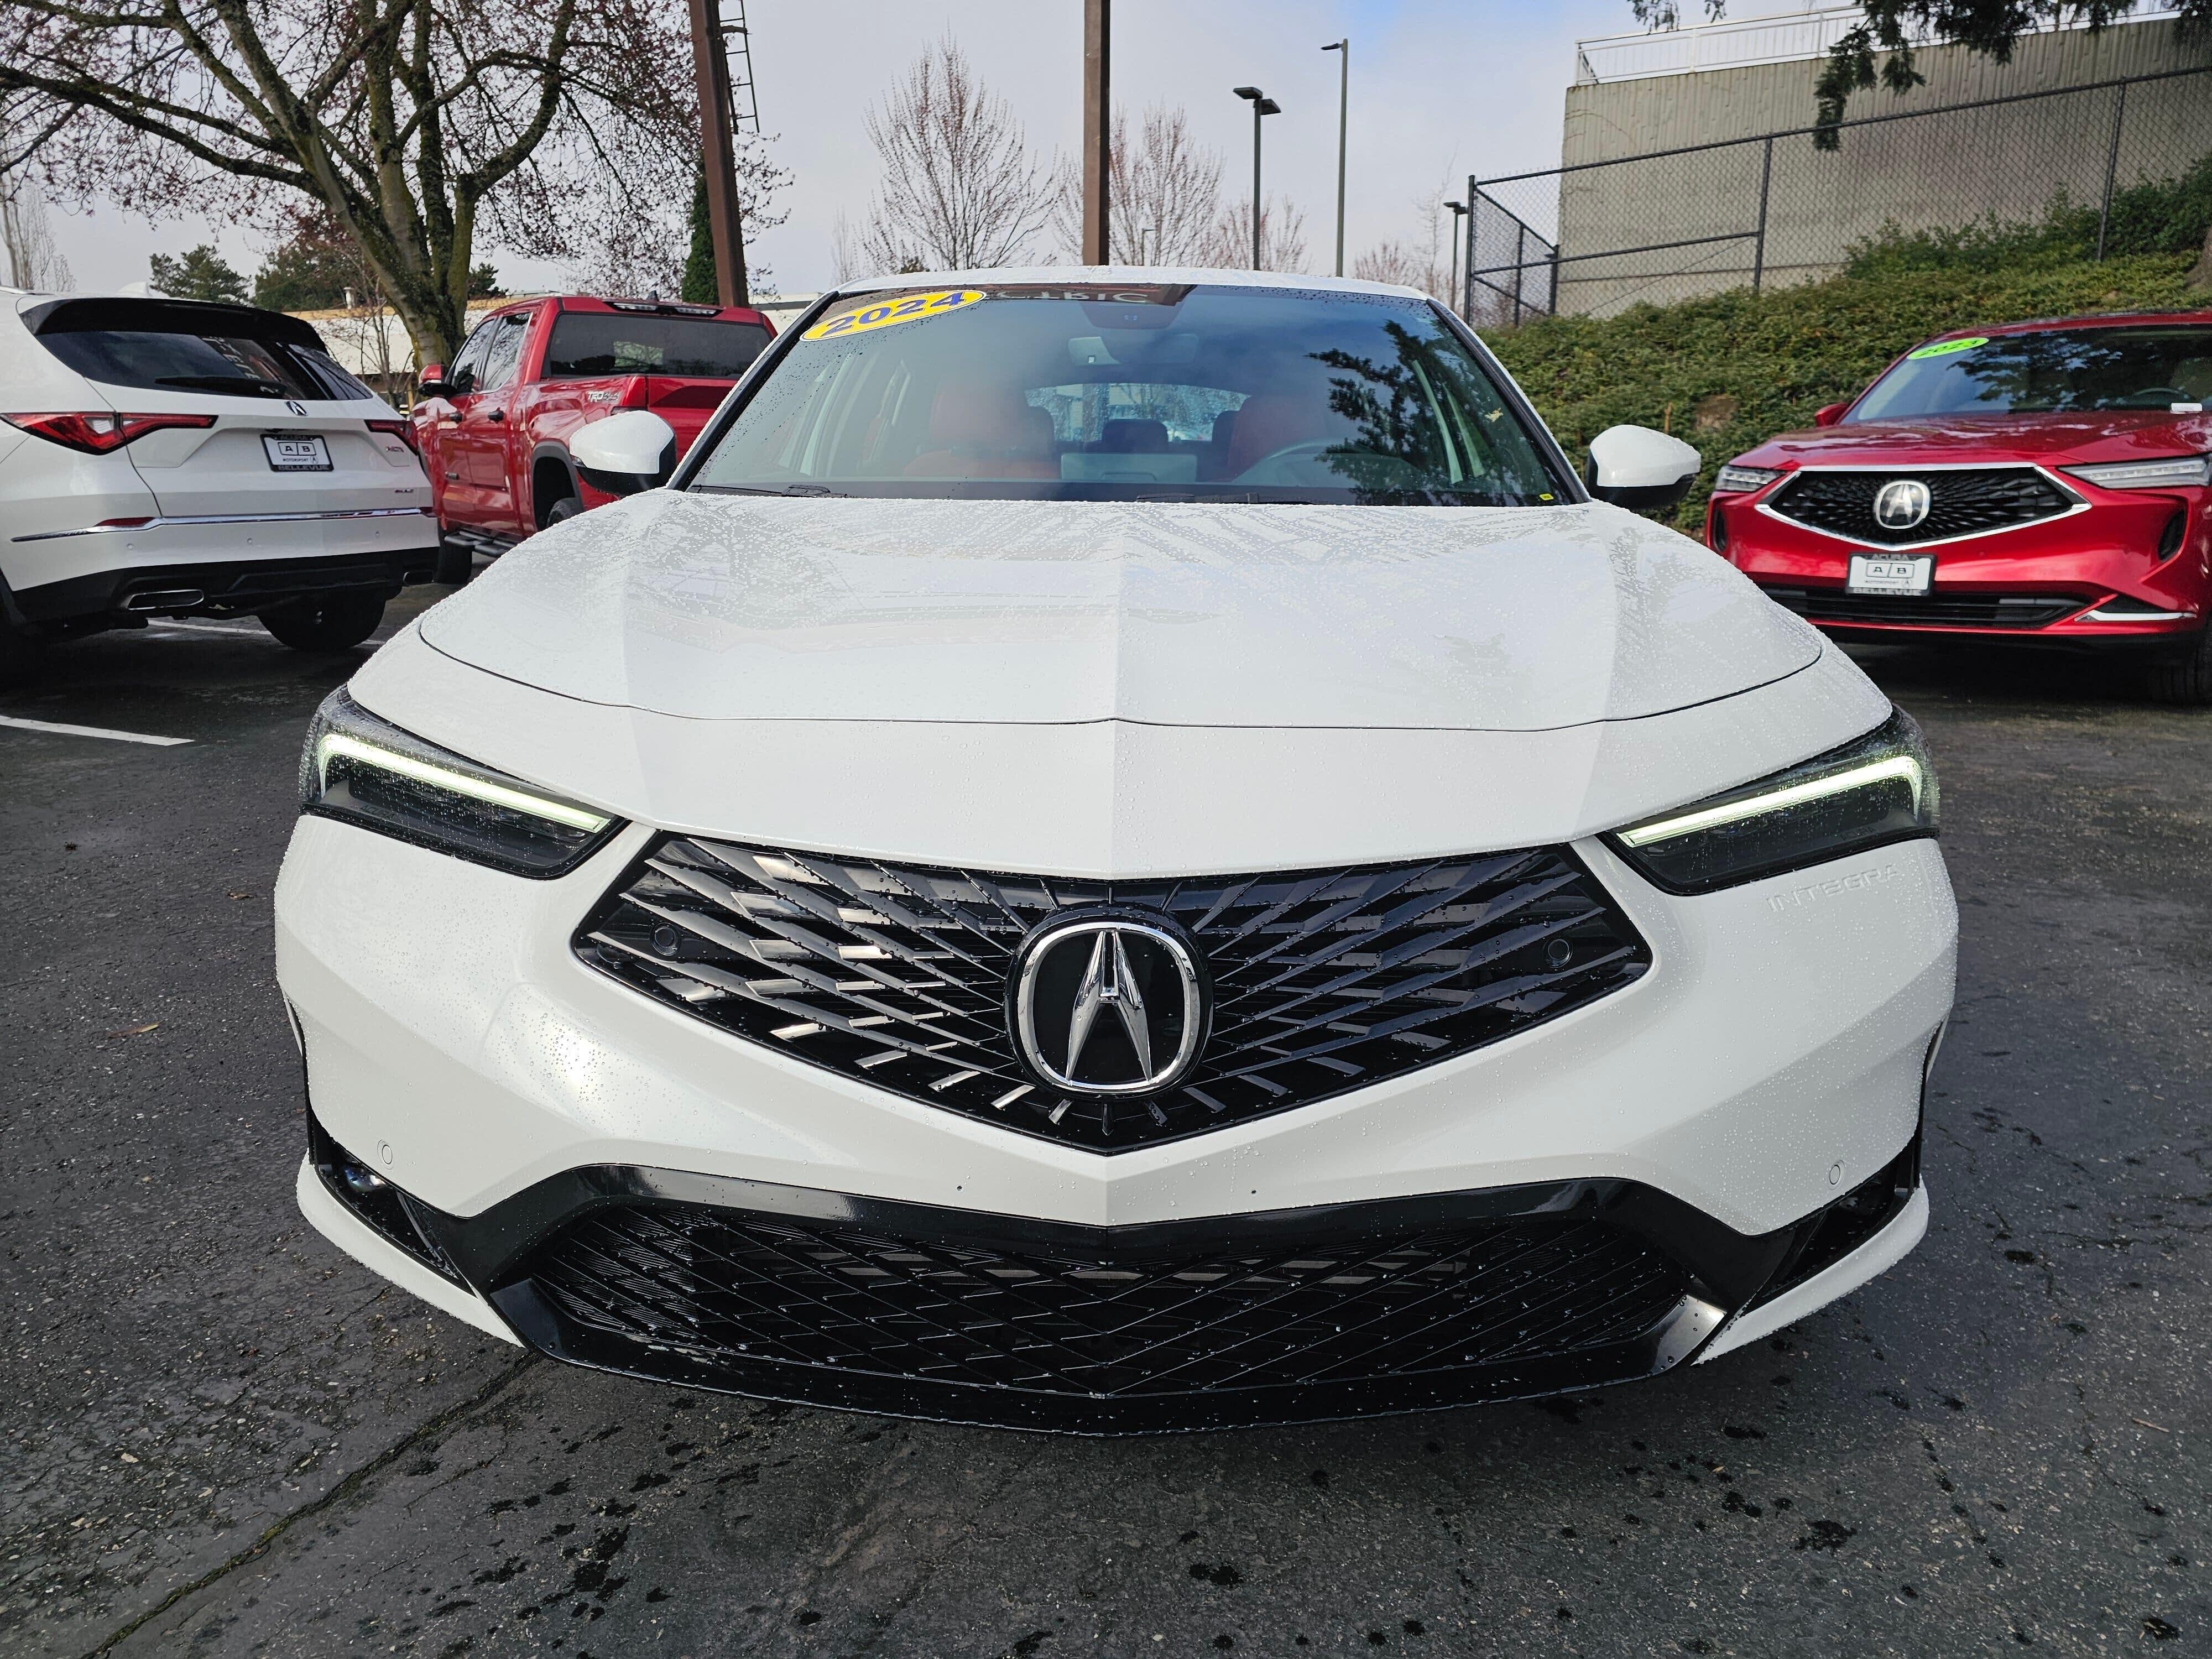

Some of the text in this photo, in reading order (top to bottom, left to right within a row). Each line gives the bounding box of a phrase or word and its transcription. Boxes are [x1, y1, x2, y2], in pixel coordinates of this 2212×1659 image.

[820, 292, 966, 337] 2024
[1853, 587, 1922, 596] BELLEVUE
[359, 805, 395, 818] ACURA
[1766, 864, 1900, 912] INTEGRA
